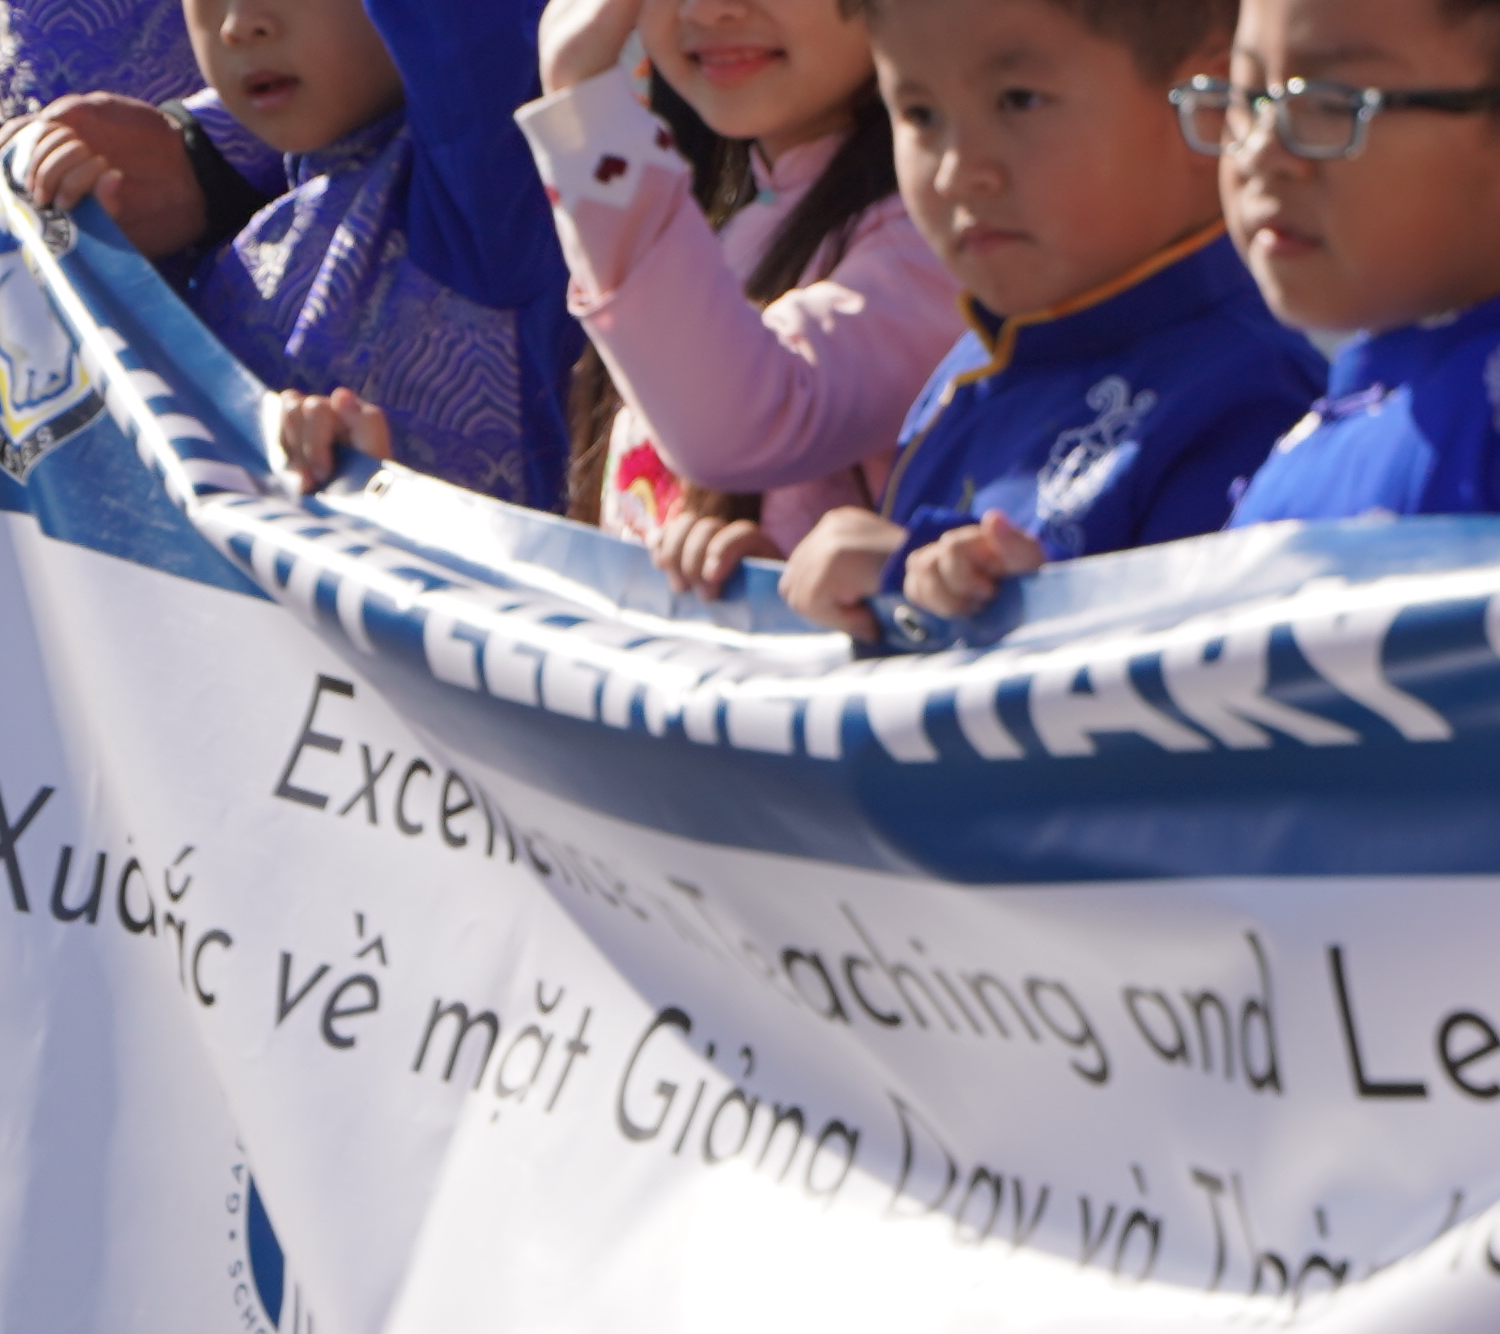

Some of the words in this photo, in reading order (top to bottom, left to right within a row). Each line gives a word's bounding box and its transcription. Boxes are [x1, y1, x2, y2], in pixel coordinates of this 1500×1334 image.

[276, 912, 389, 1051] về
[411, 979, 593, 1121] mặt
[1077, 1163, 1164, 1289] và
[1121, 929, 1284, 1096] and
